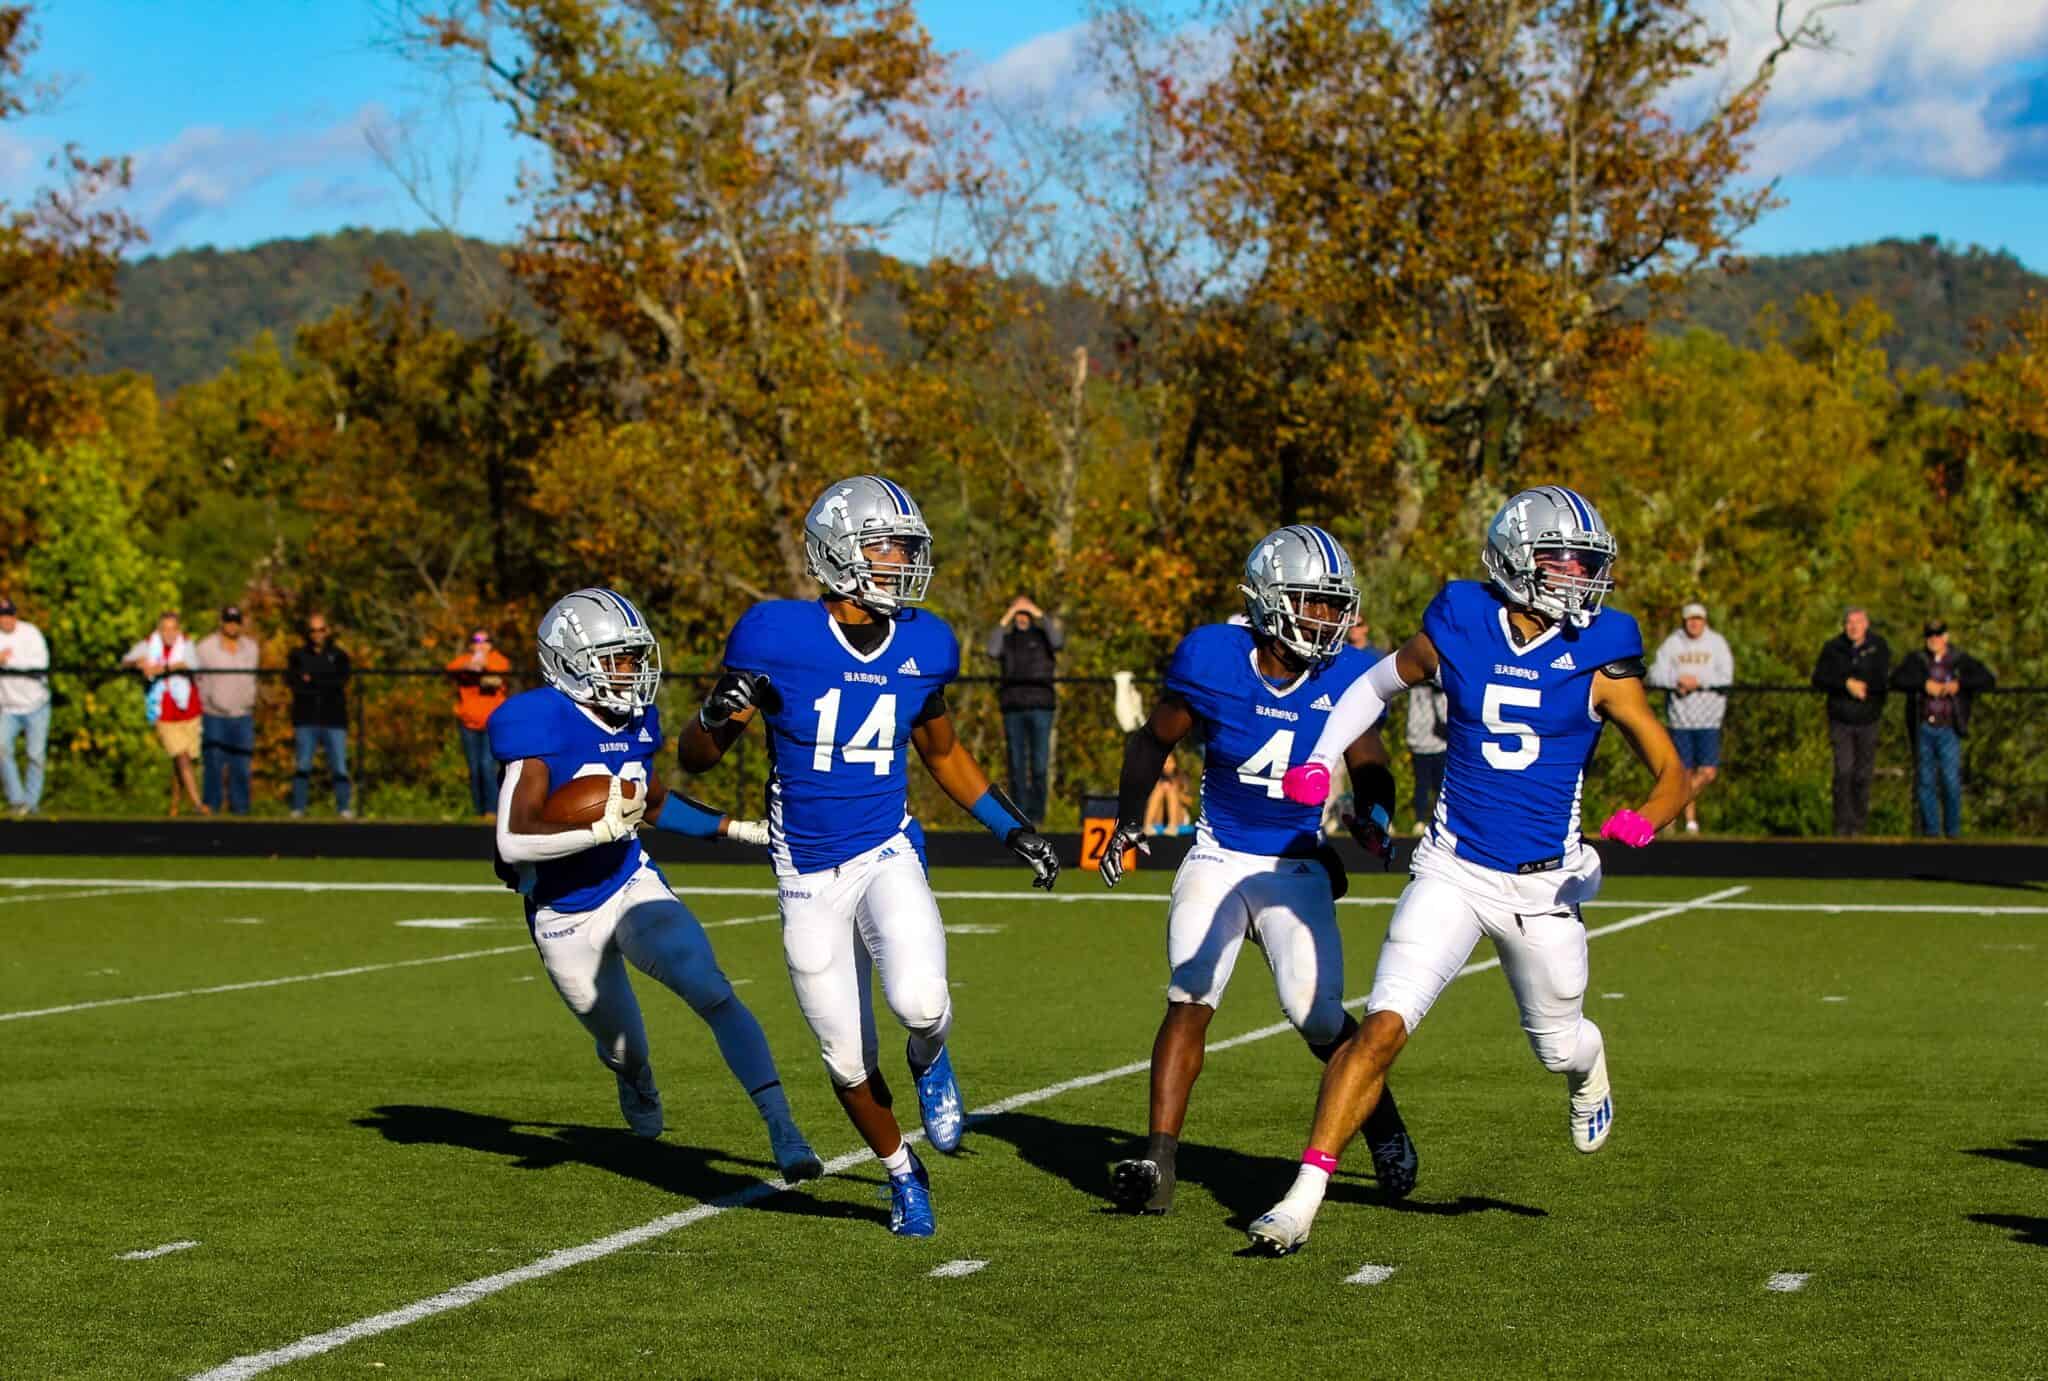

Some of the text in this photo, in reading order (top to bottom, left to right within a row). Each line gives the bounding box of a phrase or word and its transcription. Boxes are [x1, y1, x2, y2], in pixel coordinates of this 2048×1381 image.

[813, 687, 897, 776] 14
[1236, 729, 1296, 799] 4
[1481, 682, 1541, 771] 5
